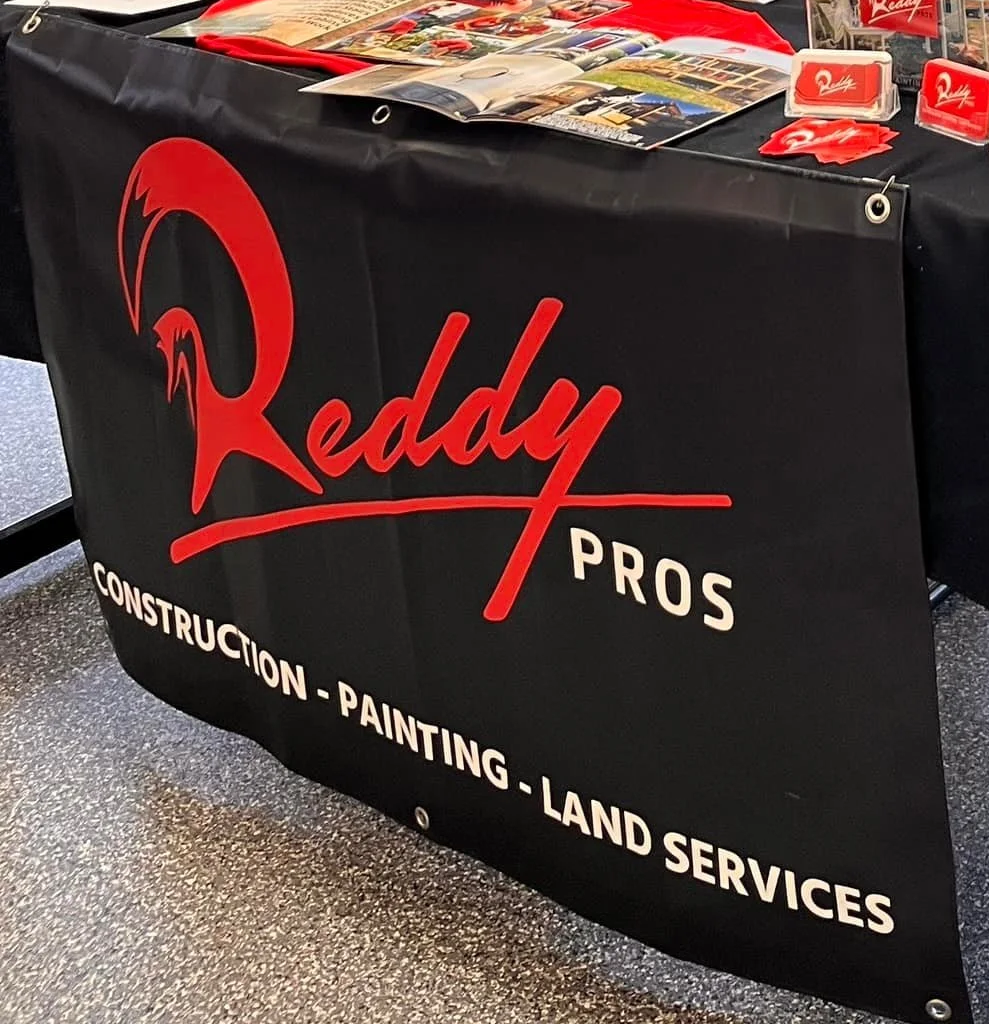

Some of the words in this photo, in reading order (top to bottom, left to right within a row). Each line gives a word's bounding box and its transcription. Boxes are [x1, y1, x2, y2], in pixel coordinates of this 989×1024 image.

[815, 69, 855, 95] Reddy
[935, 72, 973, 109] Reddy
[117, 136, 625, 622] Reddy
[570, 526, 735, 632] PROS
[92, 561, 308, 701] CONSTRUCTION
[338, 680, 509, 791] PAINTING
[542, 775, 652, 857] LAND
[664, 833, 895, 935] SERVICES
